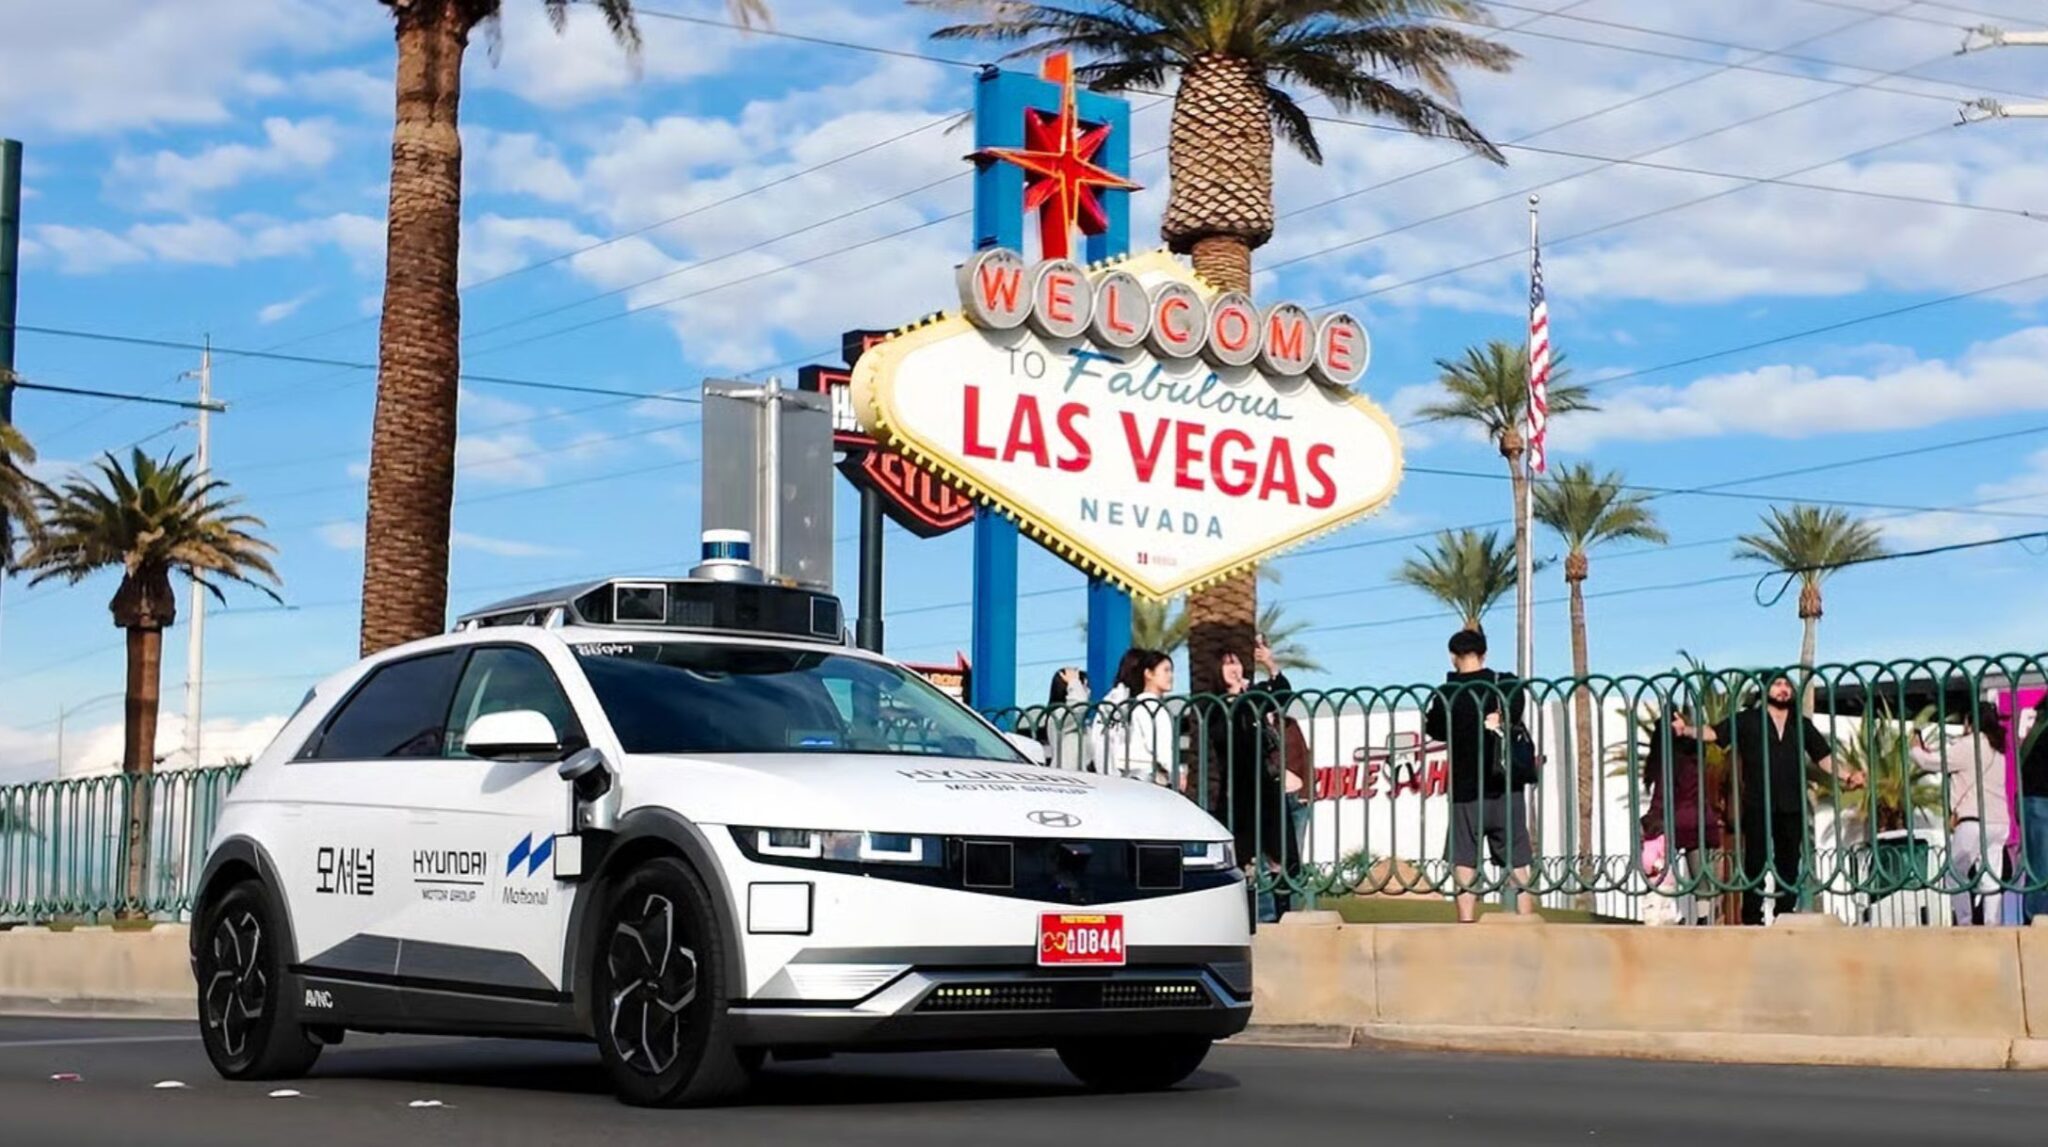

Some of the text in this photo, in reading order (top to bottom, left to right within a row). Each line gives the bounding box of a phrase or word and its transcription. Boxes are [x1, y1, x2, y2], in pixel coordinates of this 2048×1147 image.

[980, 264, 1353, 371] WELCOME
[1003, 346, 1293, 421] TO Fabulous
[962, 384, 1092, 473] LAS
[1119, 411, 1337, 510] VEGAS
[1080, 497, 1223, 539] NEVADA
[896, 769, 1088, 785] HYUNDAI
[945, 783, 1088, 795] MOTOR GROUP
[315, 846, 375, 896] 모셔널
[413, 850, 487, 875] HYUNDAI
[502, 886, 549, 906] Motional
